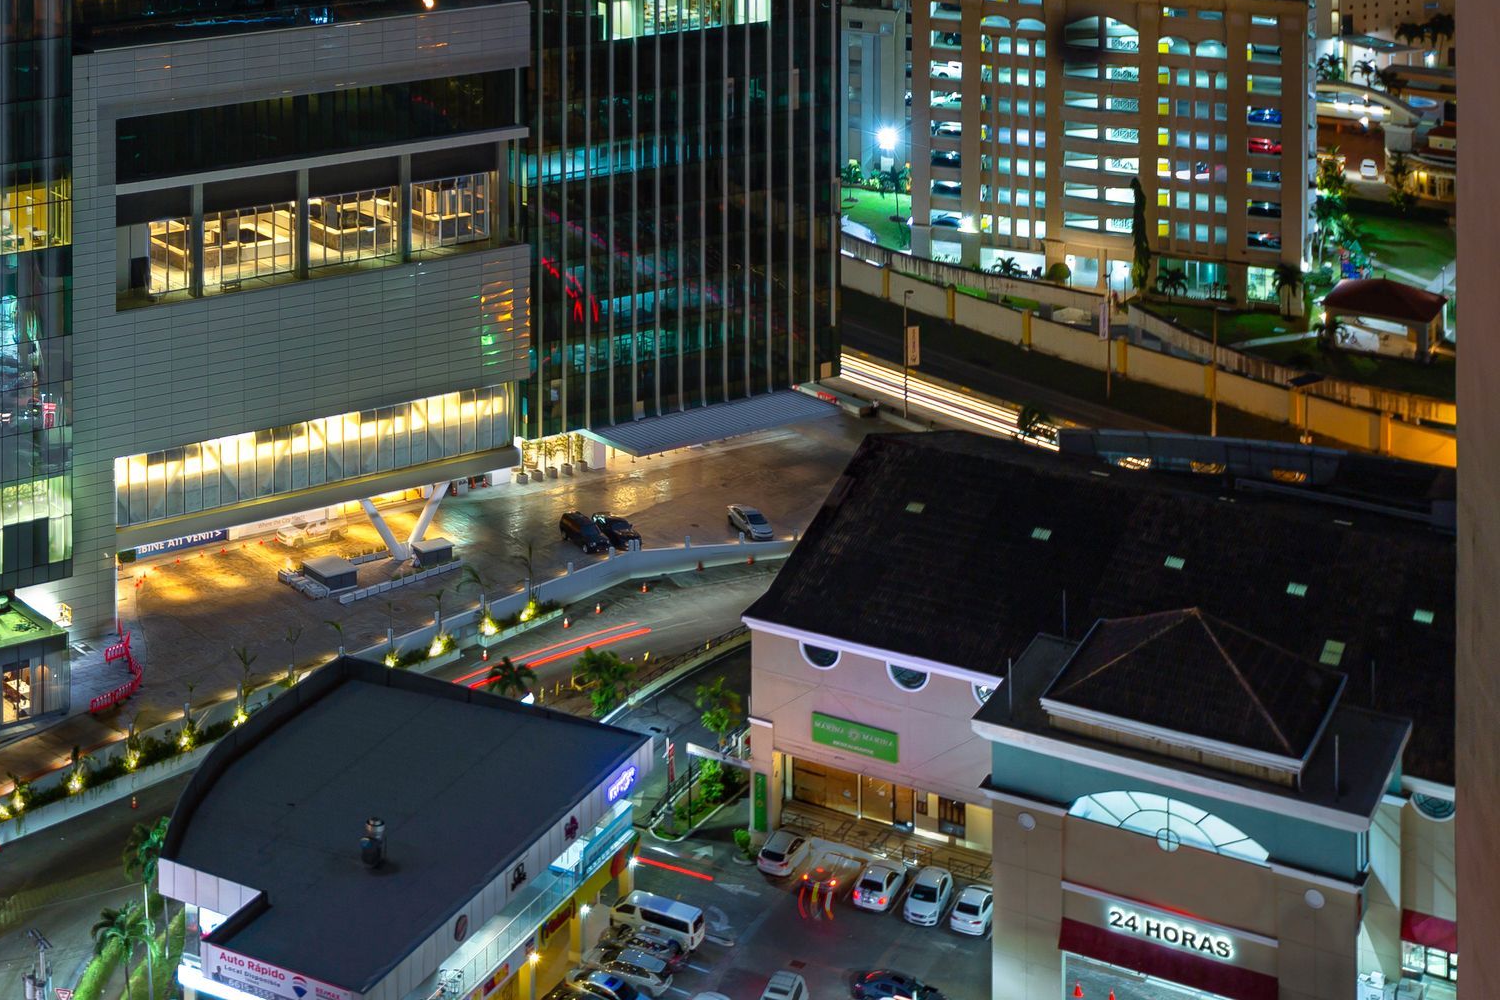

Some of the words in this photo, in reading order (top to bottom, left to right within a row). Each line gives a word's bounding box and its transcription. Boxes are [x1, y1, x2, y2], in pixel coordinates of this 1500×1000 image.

[1110, 910, 1139, 932] 24
[1145, 919, 1231, 959] HORAS
[219, 951, 245, 967] Auto
[247, 960, 285, 981] Rápido
[224, 964, 243, 975] Local
[244, 971, 281, 988] Disponible
